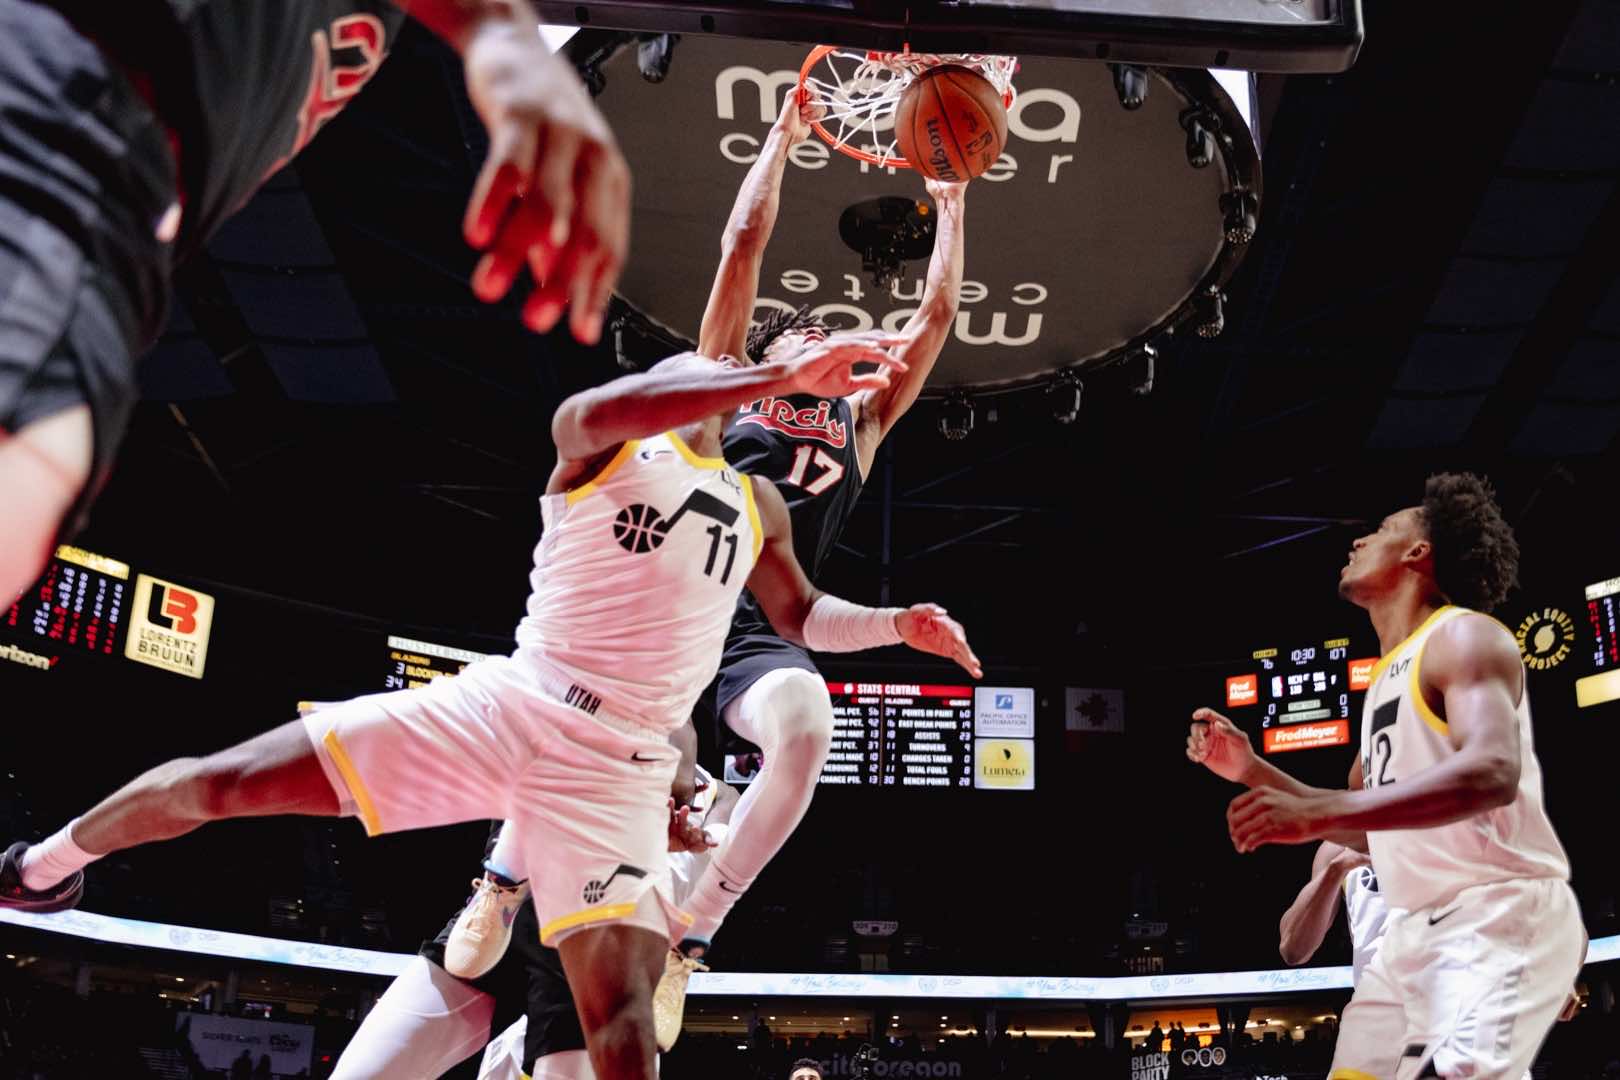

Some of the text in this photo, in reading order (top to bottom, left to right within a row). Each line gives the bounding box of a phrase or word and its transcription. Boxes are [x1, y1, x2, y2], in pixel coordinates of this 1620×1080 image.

[715, 66, 1081, 144] moa
[788, 445, 845, 496] 17
[704, 523, 738, 586] 11
[138, 639, 195, 667] BRUUN
[140, 628, 197, 654] LORENTZ
[1330, 647, 1346, 660] 107
[0, 644, 49, 670] rizon
[1261, 659, 1275, 670] 76
[1291, 648, 1315, 661] 10:30
[1523, 644, 1571, 670] PROJECT
[395, 662, 406, 675] 3
[385, 675, 404, 689] 34
[857, 683, 922, 696] STATS CENTRAL
[564, 684, 602, 716] UTAH
[1376, 732, 1396, 786] 2
[1131, 1052, 1170, 1071] BLOCK
